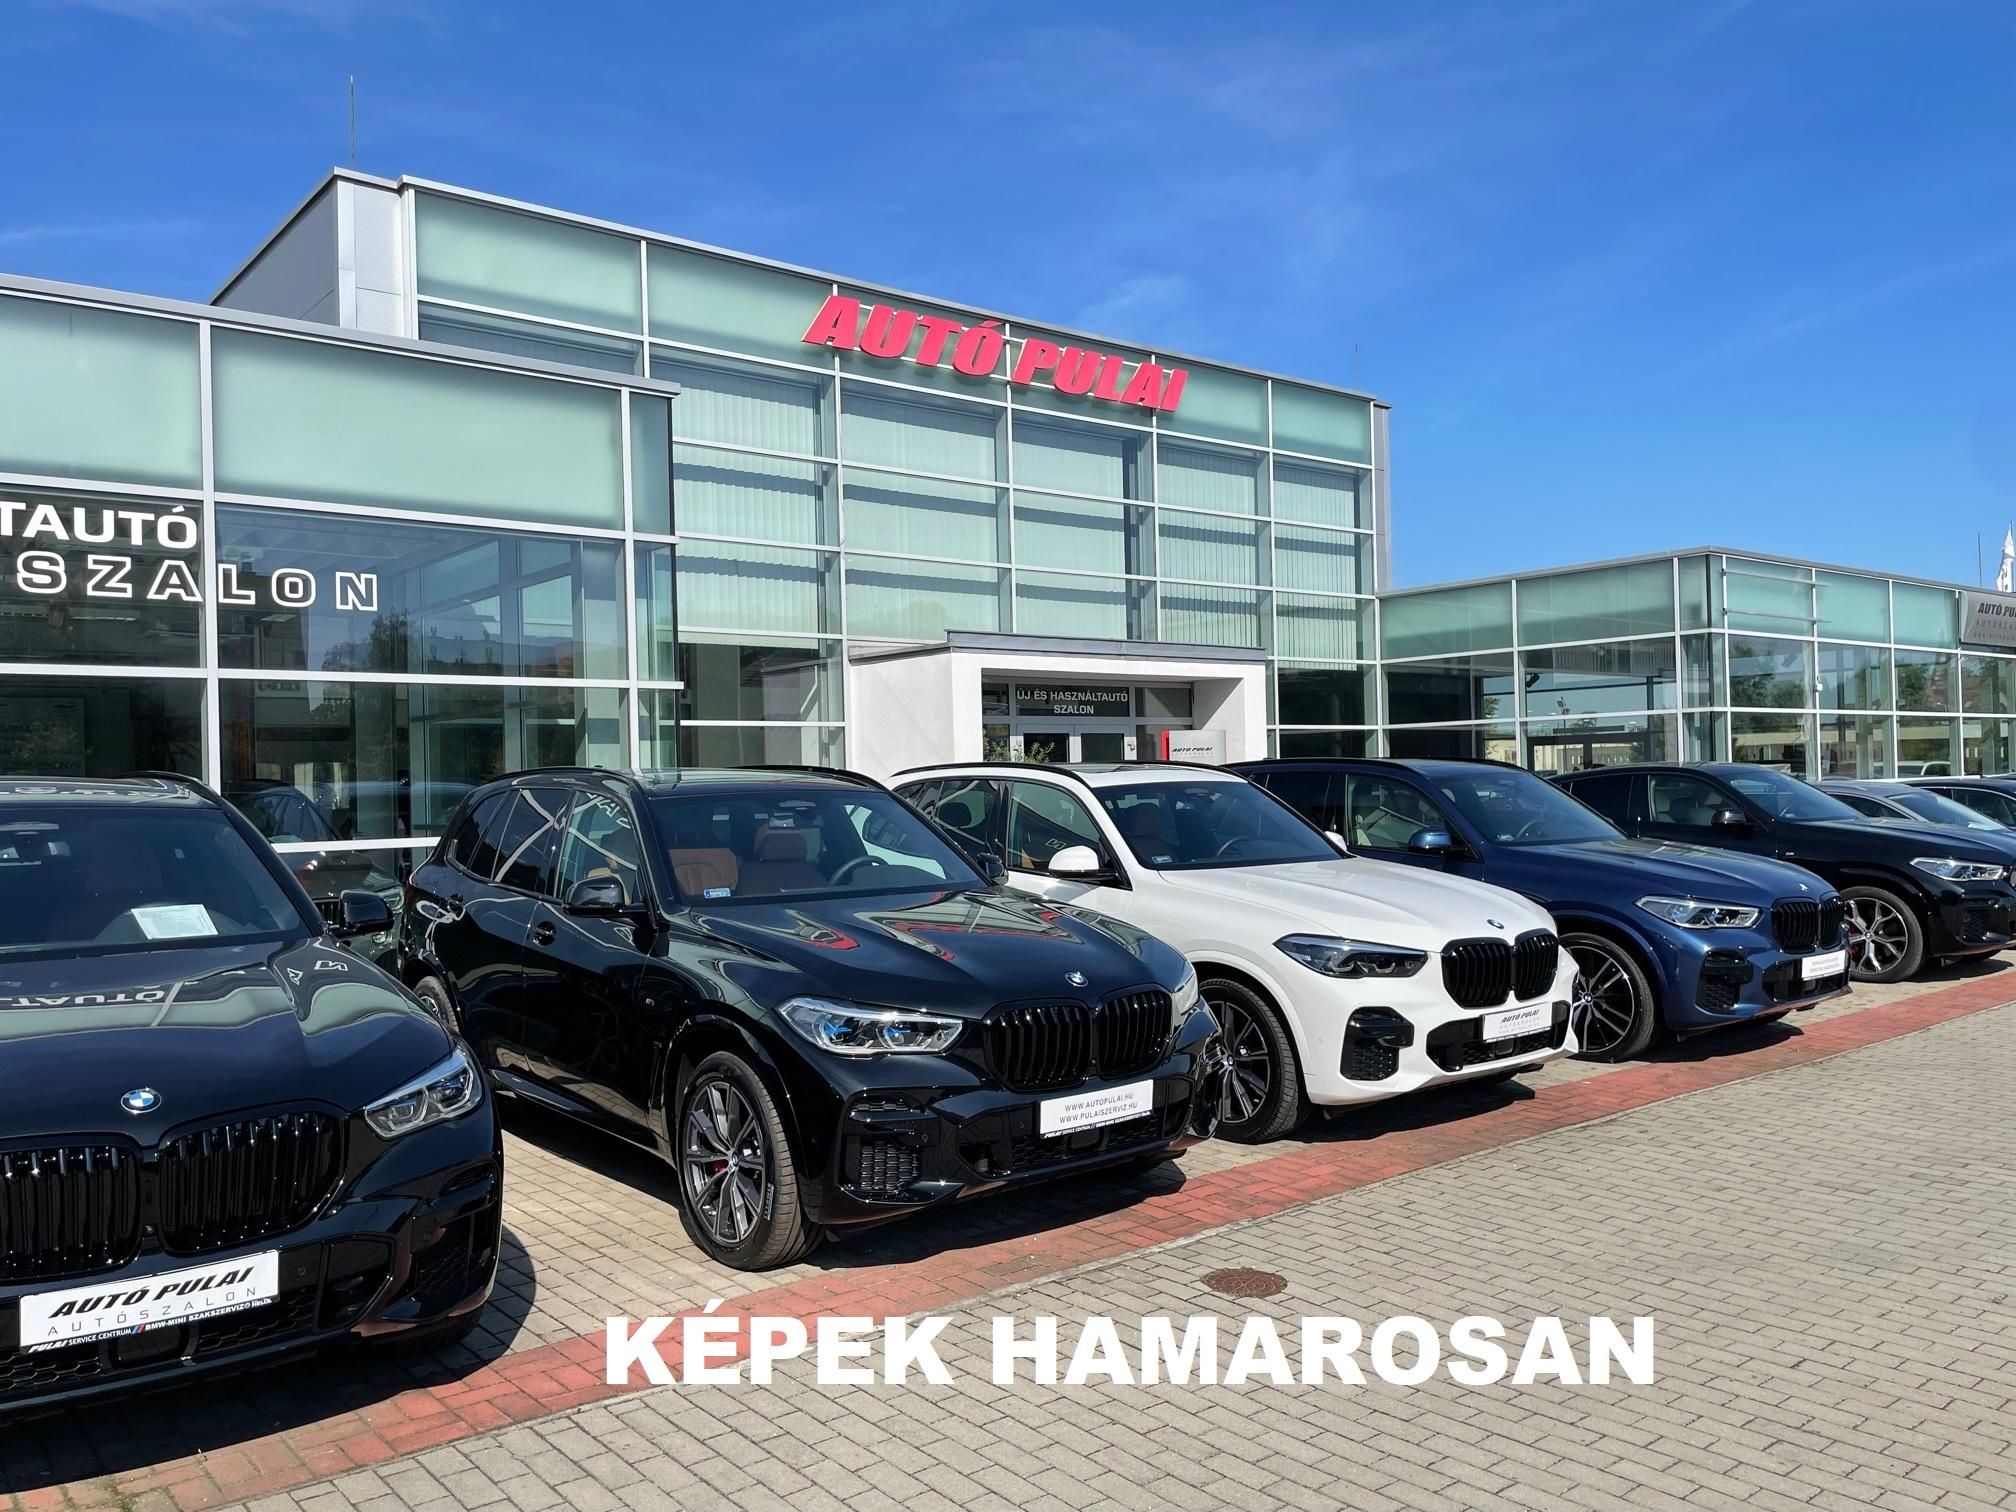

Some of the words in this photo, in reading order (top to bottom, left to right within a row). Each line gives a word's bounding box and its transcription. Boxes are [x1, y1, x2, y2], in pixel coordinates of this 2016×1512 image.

[801, 295, 1003, 376] AUTÓ
[1010, 338, 1189, 412] PULAI
[17, 550, 379, 611] SZALON
[1977, 602, 2002, 616] AUTÓ
[1017, 688, 1030, 700] ÚJ
[1034, 688, 1047, 700] ÉS
[1050, 690, 1128, 702] HASZNÁLTAUTÓ
[1053, 704, 1094, 714] SZALON
[47, 1287, 256, 1336] AUTÓSZALON
[48, 1286, 150, 1319] AUTÓ
[152, 1266, 255, 1301] PULAI
[28, 1339, 67, 1354] PULAI
[68, 1333, 98, 1346] SERVICE
[98, 1327, 132, 1340] CENTRUM
[145, 1316, 187, 1331] BMW-MINI
[189, 1303, 244, 1322] SZAKSZERVIZ
